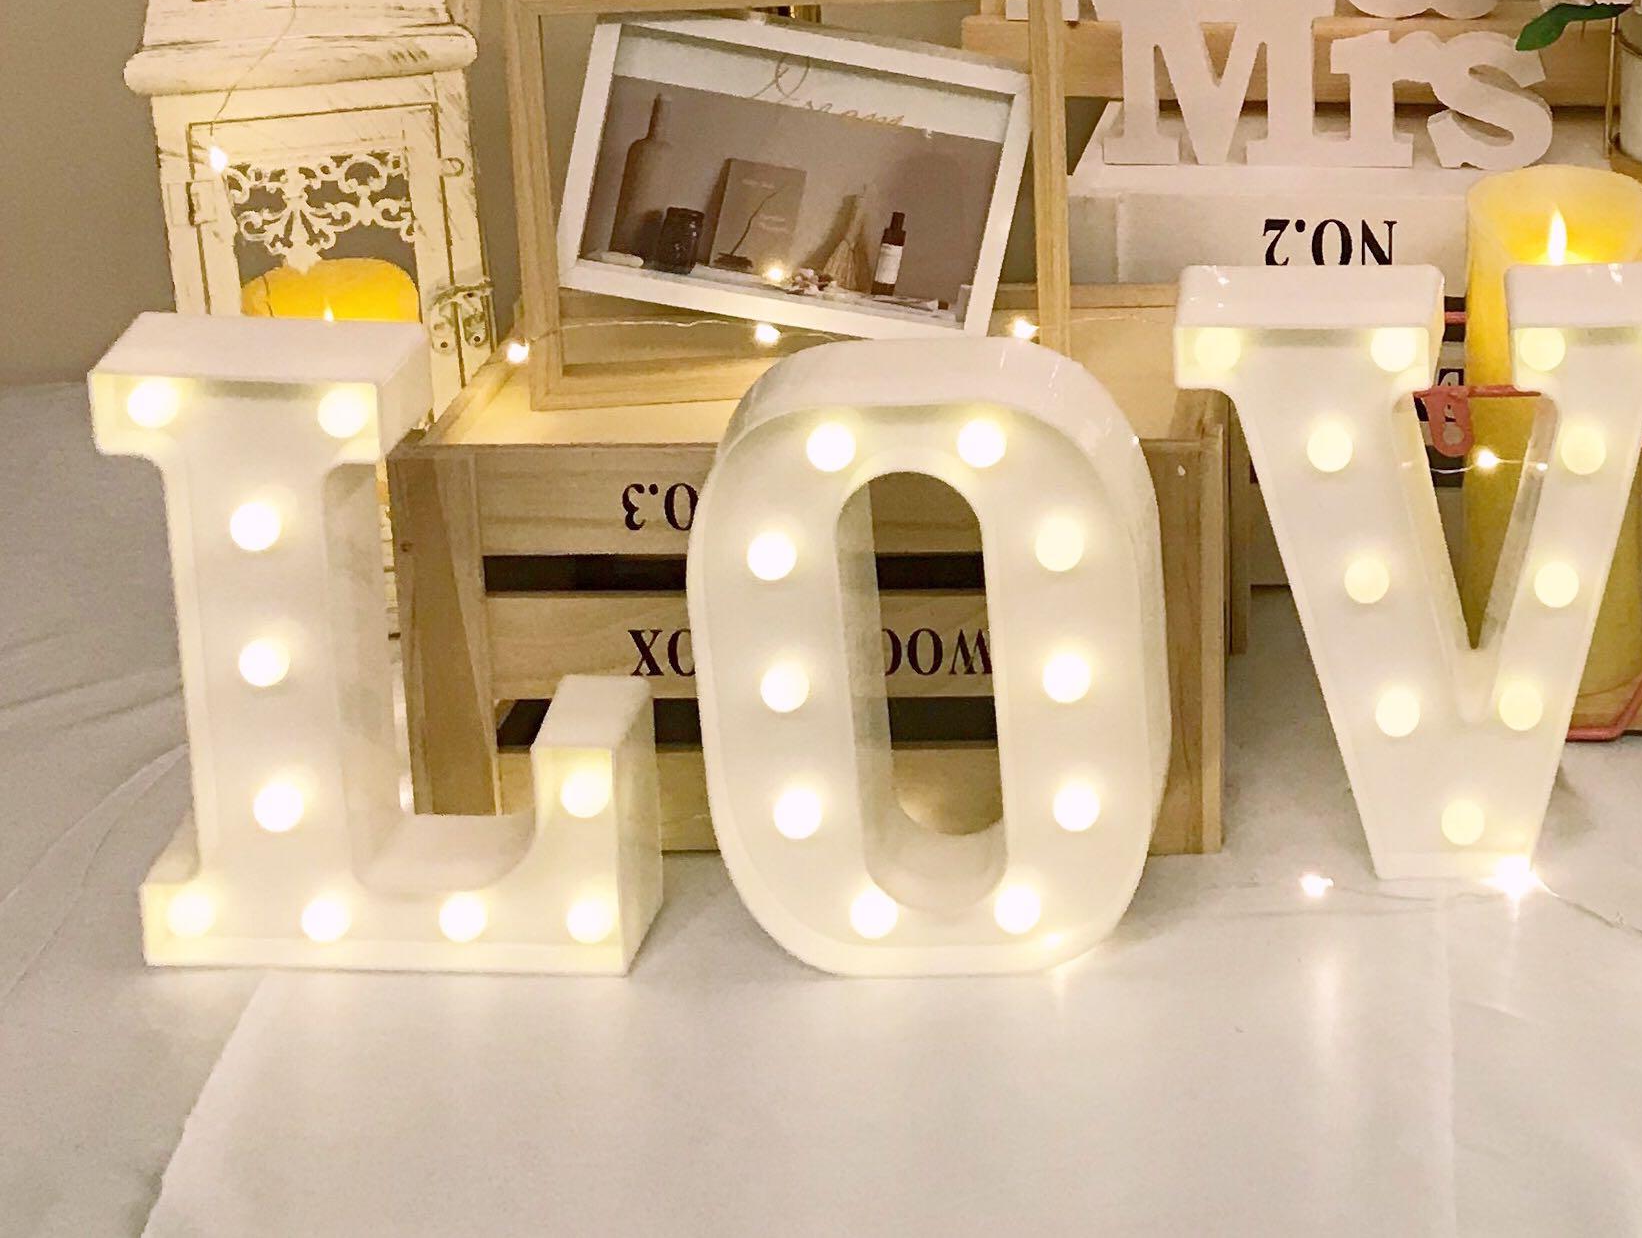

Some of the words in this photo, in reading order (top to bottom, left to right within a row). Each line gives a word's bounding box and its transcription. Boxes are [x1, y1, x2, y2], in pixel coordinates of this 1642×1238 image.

[1262, 218, 1398, 266] NO.2
[621, 482, 699, 531] O.3
[627, 629, 697, 677] OX
